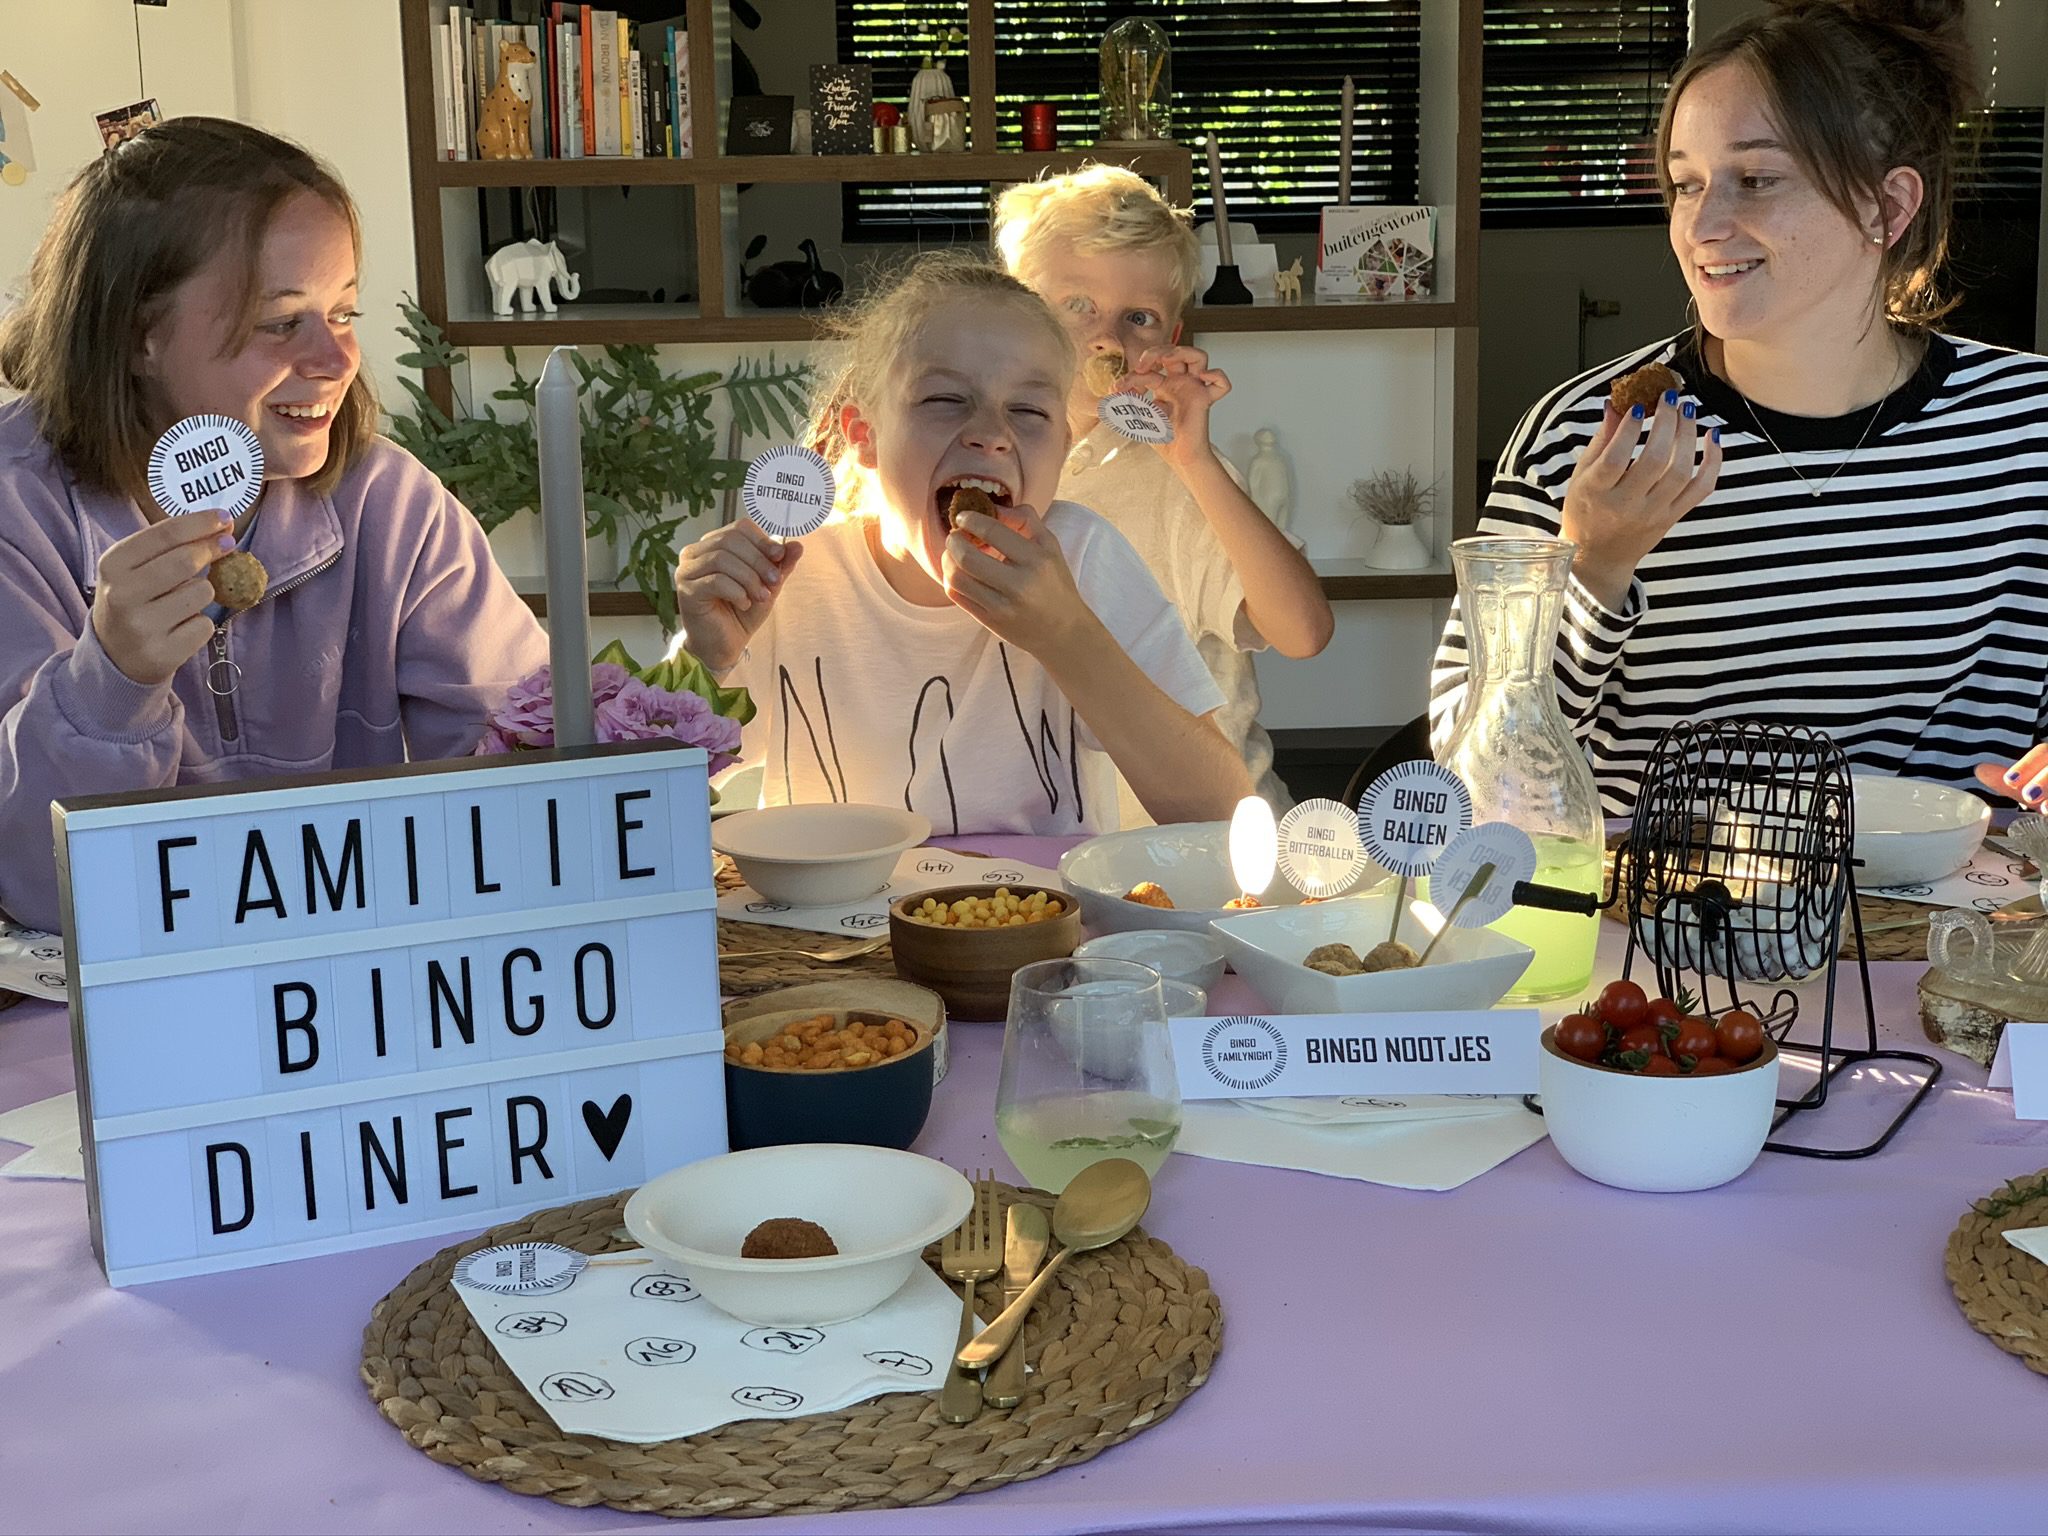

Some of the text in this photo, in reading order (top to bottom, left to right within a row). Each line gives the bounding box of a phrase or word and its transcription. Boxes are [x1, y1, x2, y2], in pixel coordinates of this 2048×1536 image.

[600, 44, 610, 84] BROWN
[823, 100, 858, 112] Friend
[824, 114, 855, 130] You
[1323, 207, 1431, 257] buitengewoon
[1111, 404, 1154, 419] BALLEN
[1125, 419, 1160, 433] BINGO
[174, 435, 230, 473] BINGO
[180, 461, 246, 504] BALLEN
[776, 471, 805, 487] BINGO
[756, 485, 822, 506] BITTERBALLEN
[1393, 788, 1448, 814] BINGO
[1307, 826, 1336, 842] BINGO
[1383, 819, 1448, 845] BALLEN
[157, 789, 656, 933] FAMILIE
[1288, 841, 1354, 861] BITTERBALLEN
[273, 942, 617, 1074] BINGO
[1230, 1038, 1257, 1049] BINGO
[1306, 1036, 1491, 1064] BINGO NOOTJES
[1217, 1049, 1273, 1063] FAMILYNIGHT
[205, 1095, 555, 1235] DINER
[496, 1260, 513, 1277] BINGO
